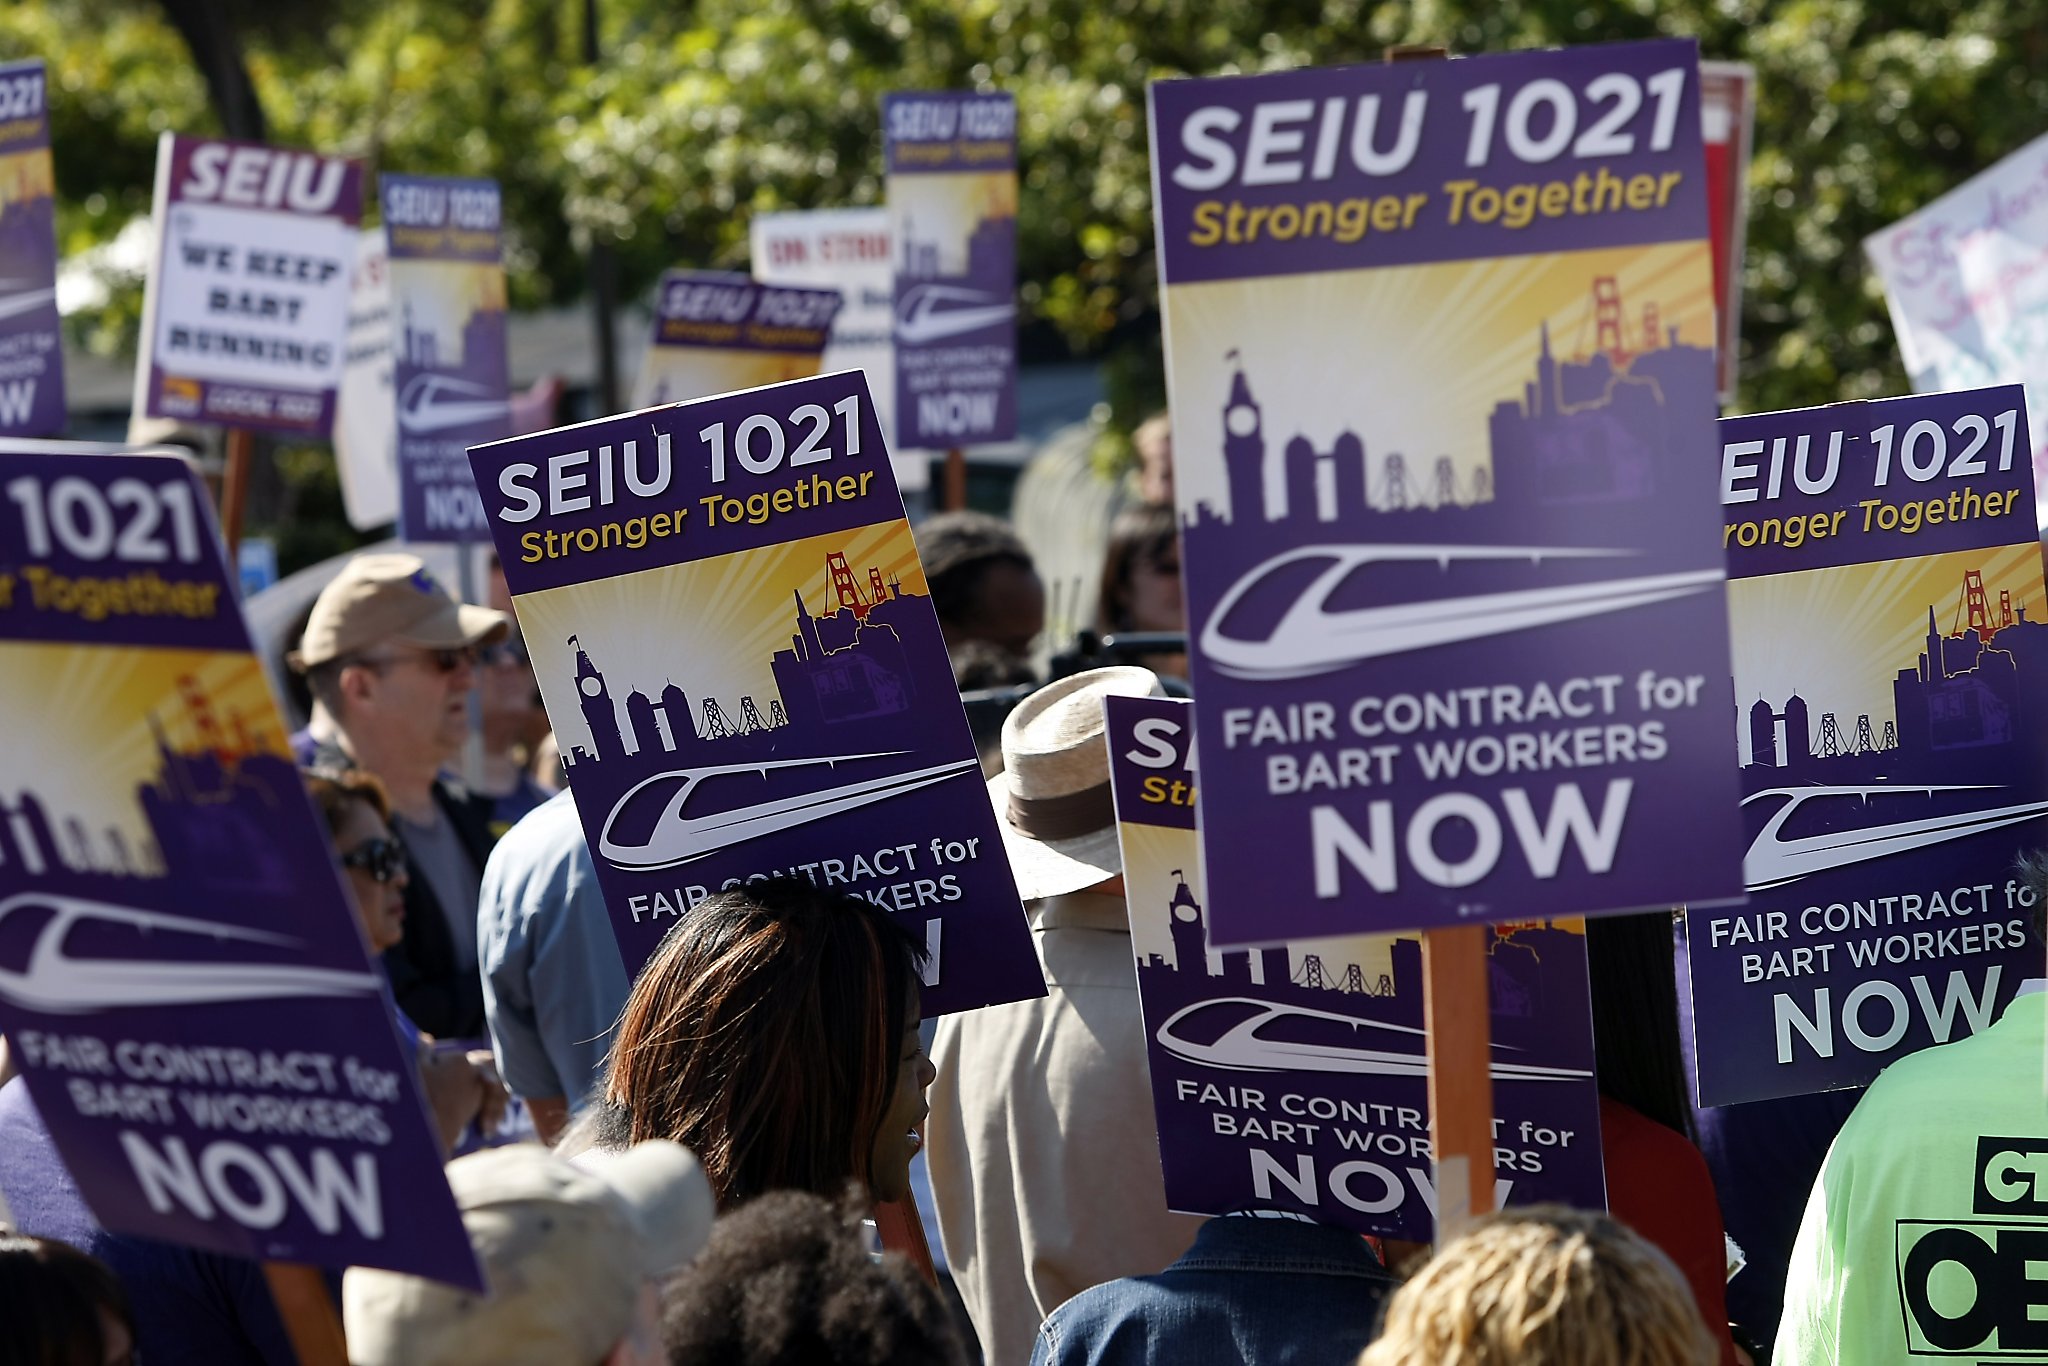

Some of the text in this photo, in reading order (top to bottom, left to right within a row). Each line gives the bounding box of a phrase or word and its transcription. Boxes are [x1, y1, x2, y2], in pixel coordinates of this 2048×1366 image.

[0, 74, 43, 120] 021
[1171, 67, 1685, 190] SEIU 1021
[181, 144, 346, 213] SEIU
[1188, 167, 1682, 247] Stronger Together
[665, 283, 756, 324] SEIU
[919, 392, 999, 438] NOW
[498, 394, 860, 523] SEIU 1021
[1720, 409, 2017, 505] EIU 1021
[7, 475, 200, 562] 1021
[521, 470, 873, 563] Stronger Together
[1722, 486, 2020, 549] ronger Together
[22, 565, 219, 622] Together
[1222, 702, 1336, 748] FAIR
[1350, 676, 1623, 737] CONTRACT
[1637, 671, 1705, 710] for
[1267, 721, 1669, 795] BART WORKERS
[1310, 778, 1634, 898] NOW
[627, 837, 980, 923] FAIR TRACT for
[847, 874, 962, 914] KERS
[1710, 880, 2038, 948] FAIR CONTRACT fo
[1742, 919, 2026, 983] BART WORKERS
[1773, 965, 2003, 1064] NOW
[18, 1030, 400, 1101] FAIR CONTRACT for
[67, 1077, 392, 1145] BART WORKERS
[1176, 1080, 1575, 1148] FAIR CONTRT for
[1213, 1112, 1543, 1173] BART WORRS
[119, 1132, 384, 1240] NOW
